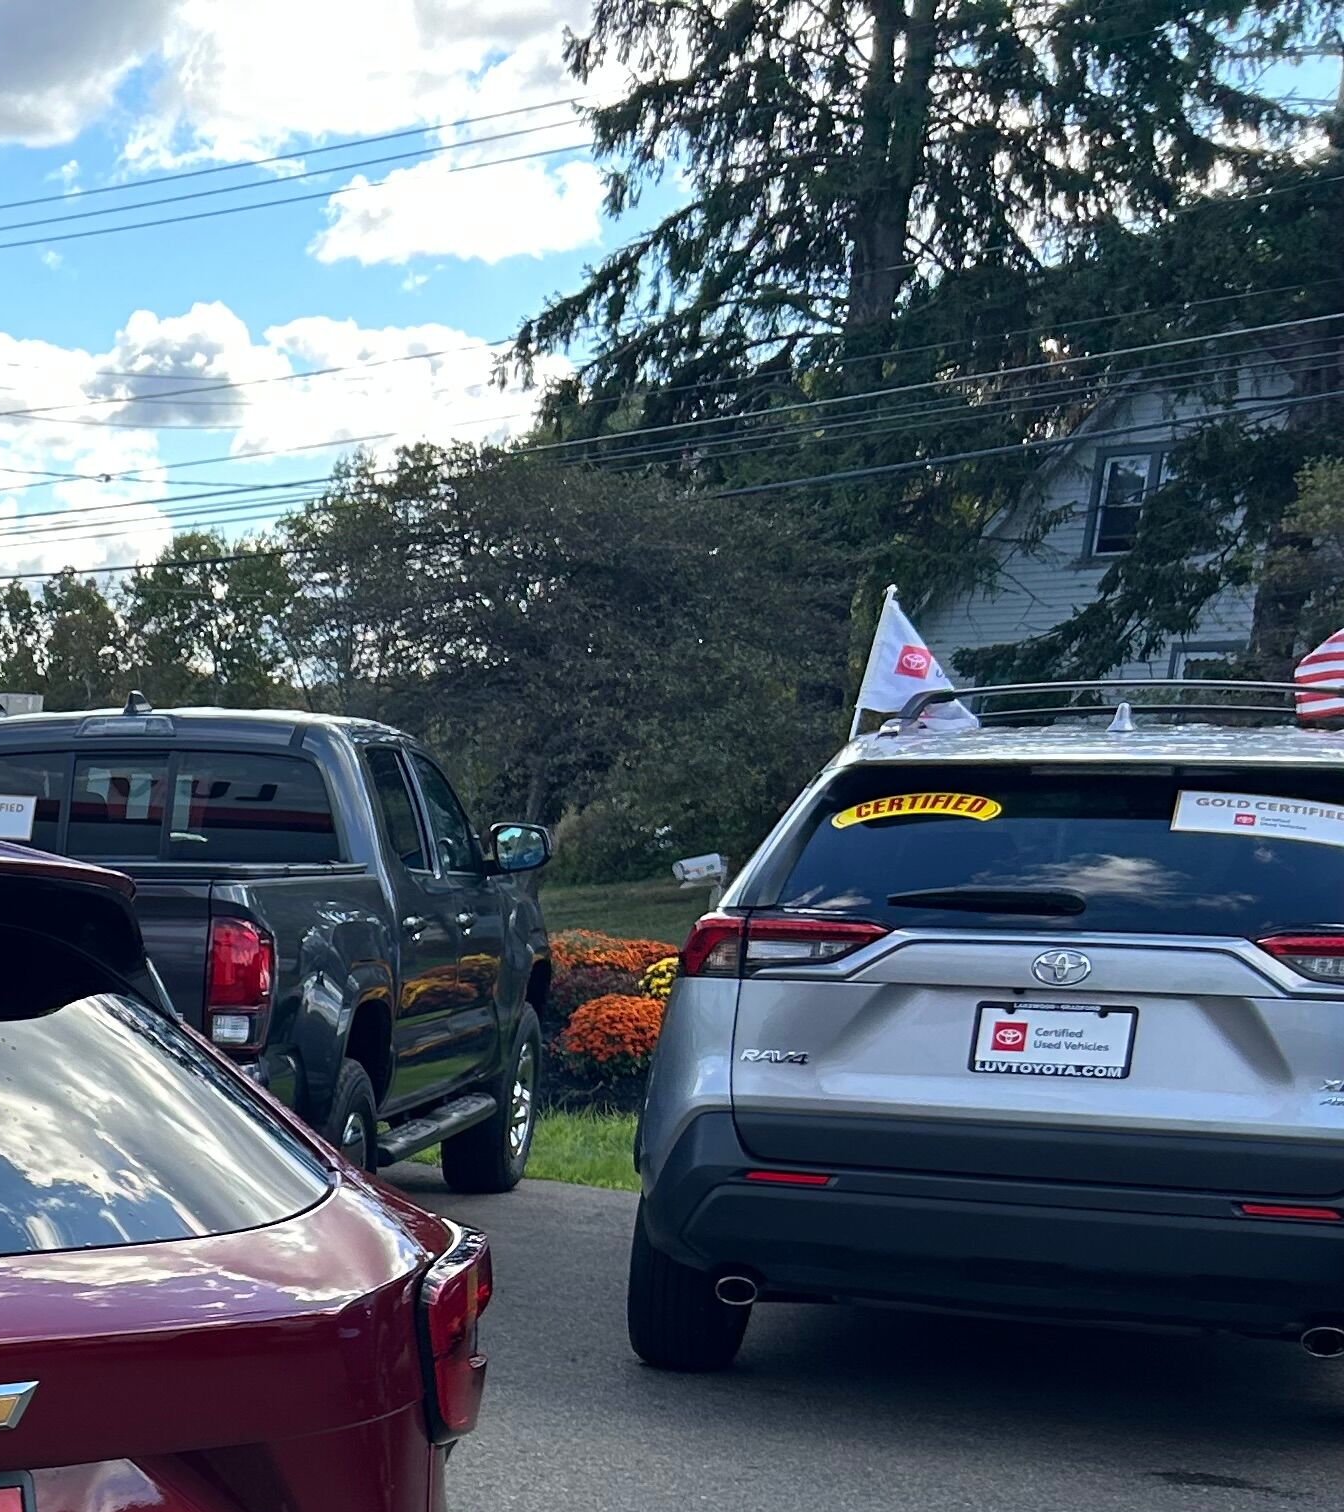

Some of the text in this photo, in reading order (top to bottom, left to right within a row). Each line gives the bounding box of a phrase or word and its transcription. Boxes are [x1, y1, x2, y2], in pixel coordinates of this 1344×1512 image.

[855, 793, 989, 819] CERTIFIED
[1195, 797, 1251, 809] GOLD
[1034, 1027, 1084, 1039] Certified
[1033, 1039, 1110, 1053] Used Vehicles
[739, 1048, 810, 1066] RAV4
[974, 1060, 1122, 1079] LUVTOYOTA.COM
